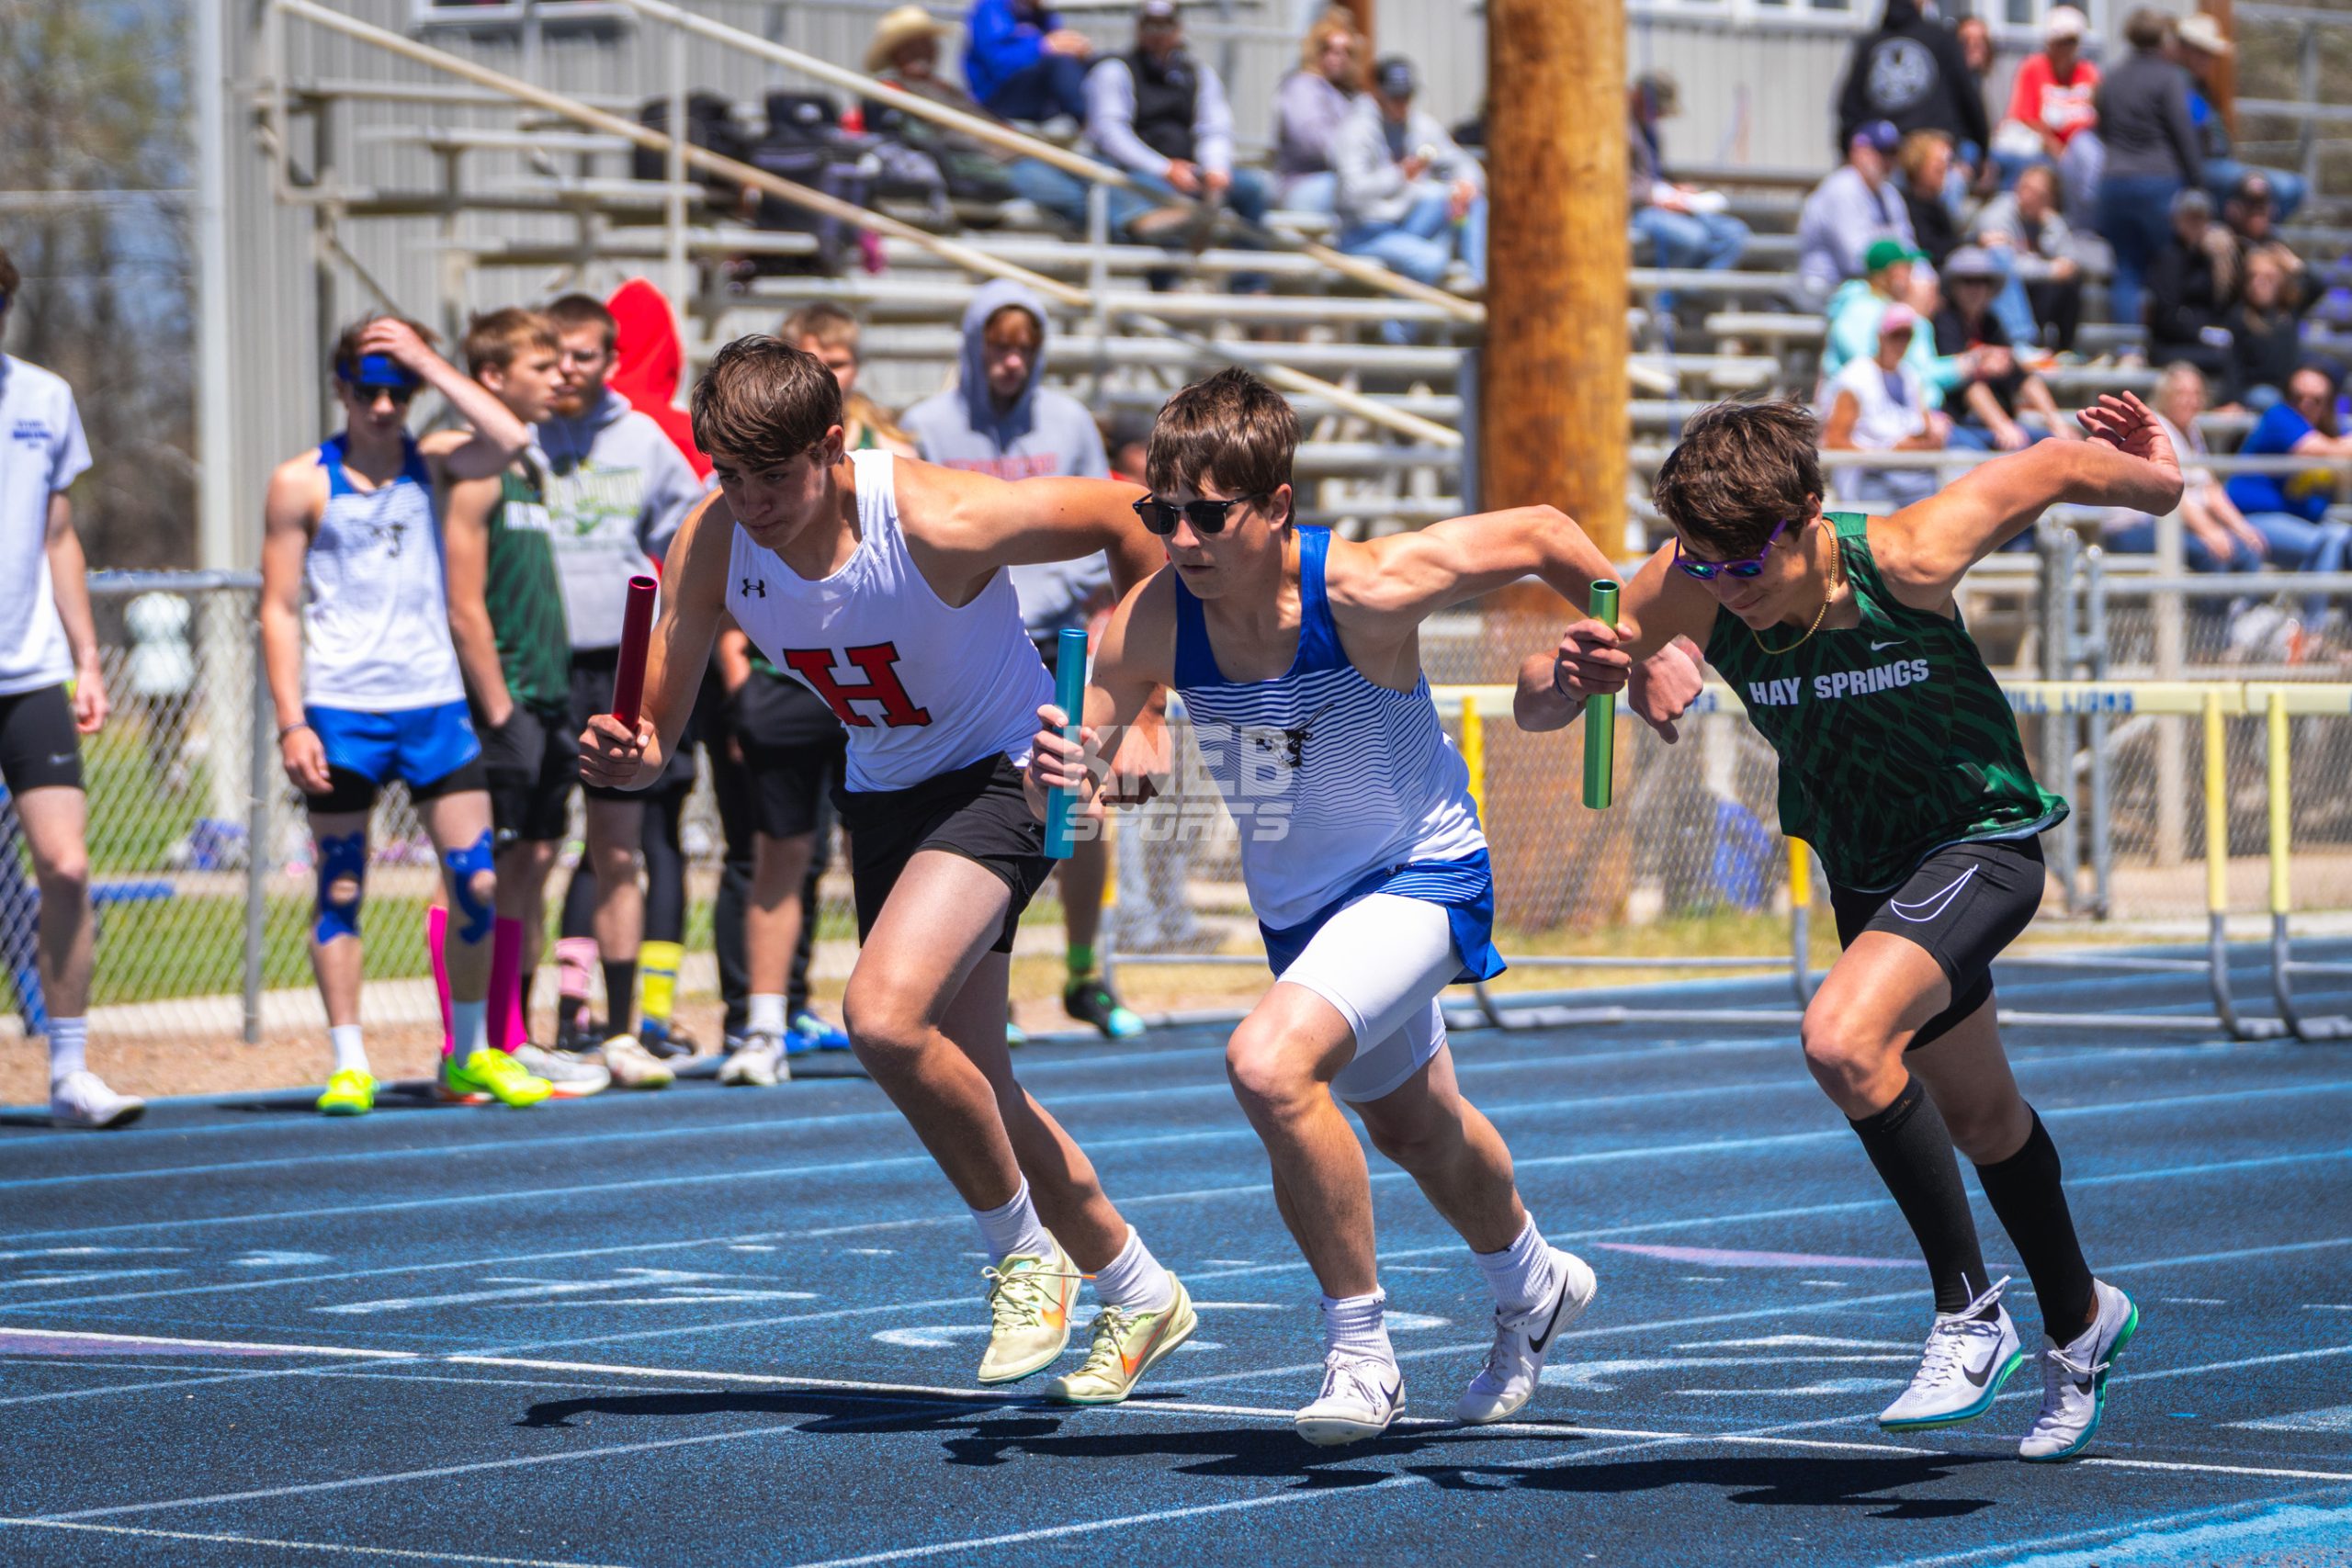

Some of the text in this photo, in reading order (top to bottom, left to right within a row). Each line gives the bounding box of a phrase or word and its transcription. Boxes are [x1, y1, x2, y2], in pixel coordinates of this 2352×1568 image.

[783, 641, 933, 728] H
[1748, 676, 1802, 705] HAY
[1814, 659, 1929, 699] SPRINGS
